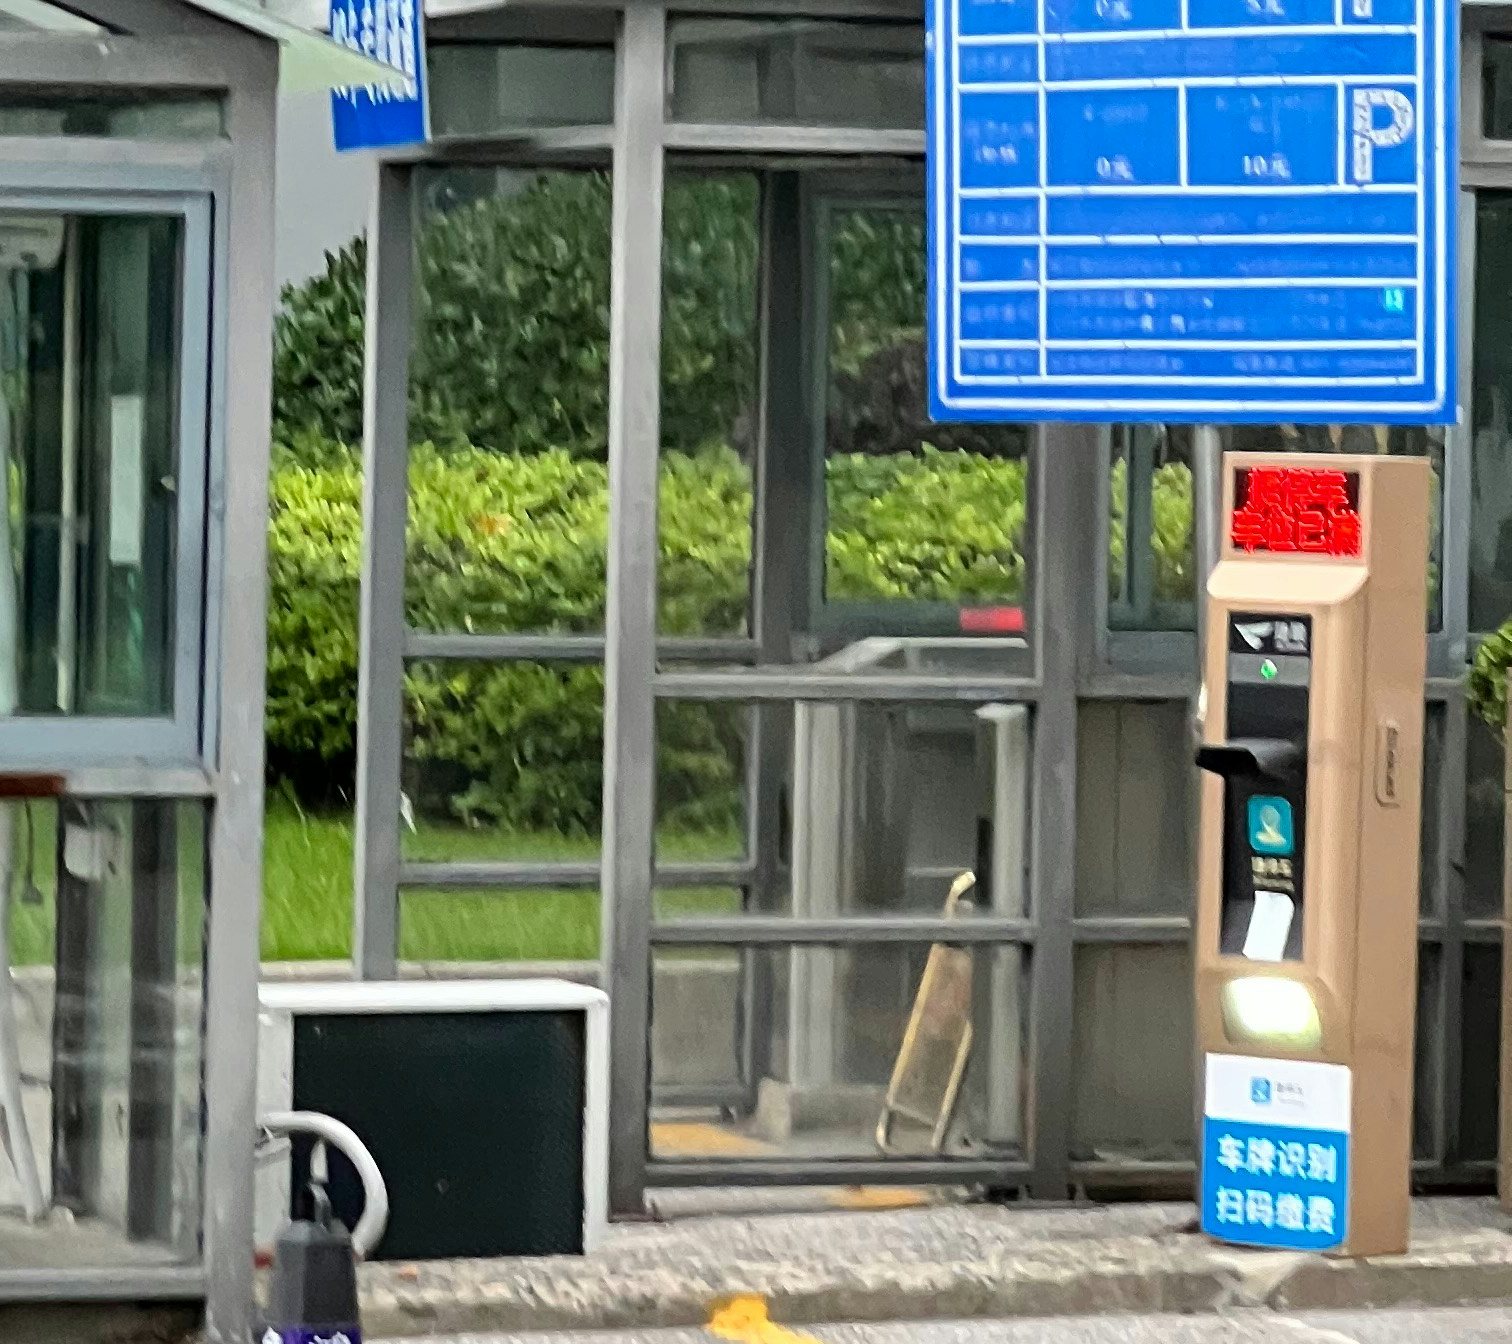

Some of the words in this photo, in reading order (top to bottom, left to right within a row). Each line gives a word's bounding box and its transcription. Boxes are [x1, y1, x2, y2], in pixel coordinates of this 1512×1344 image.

[1352, 88, 1414, 182] P
[1216, 1133, 1338, 1184] 车牌识别
[1215, 1184, 1337, 1236] 扫码缴费
